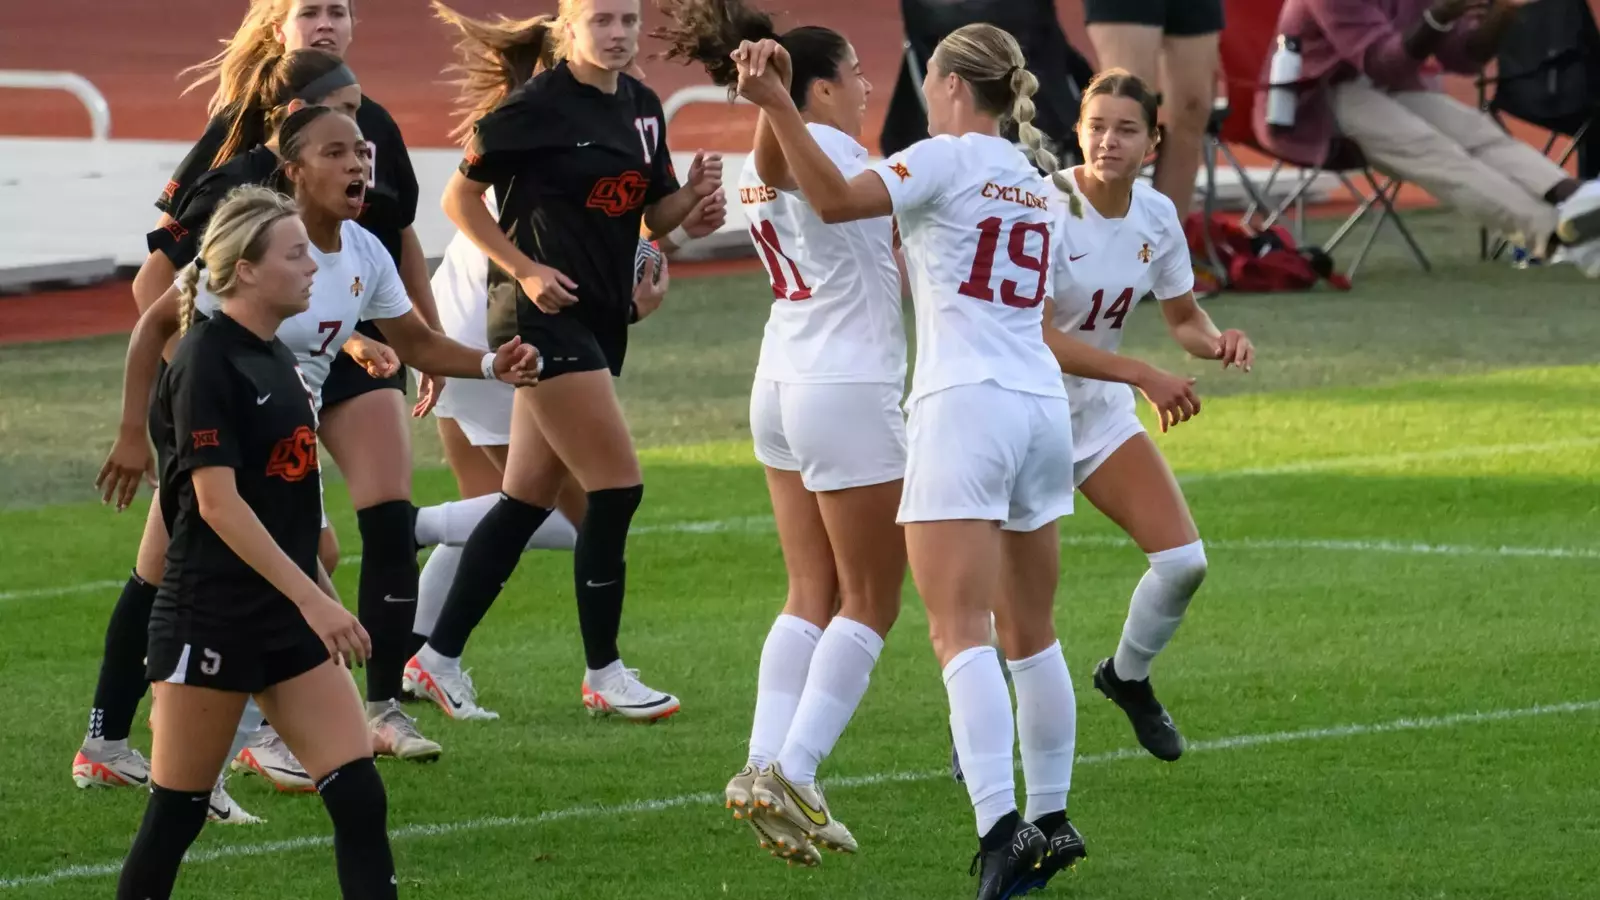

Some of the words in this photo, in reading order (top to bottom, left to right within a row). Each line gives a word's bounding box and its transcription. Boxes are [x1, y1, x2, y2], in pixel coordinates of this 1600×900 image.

[633, 115, 660, 165] 17
[957, 215, 1050, 309] 19
[1079, 286, 1135, 332] 14
[309, 320, 343, 358] 7
